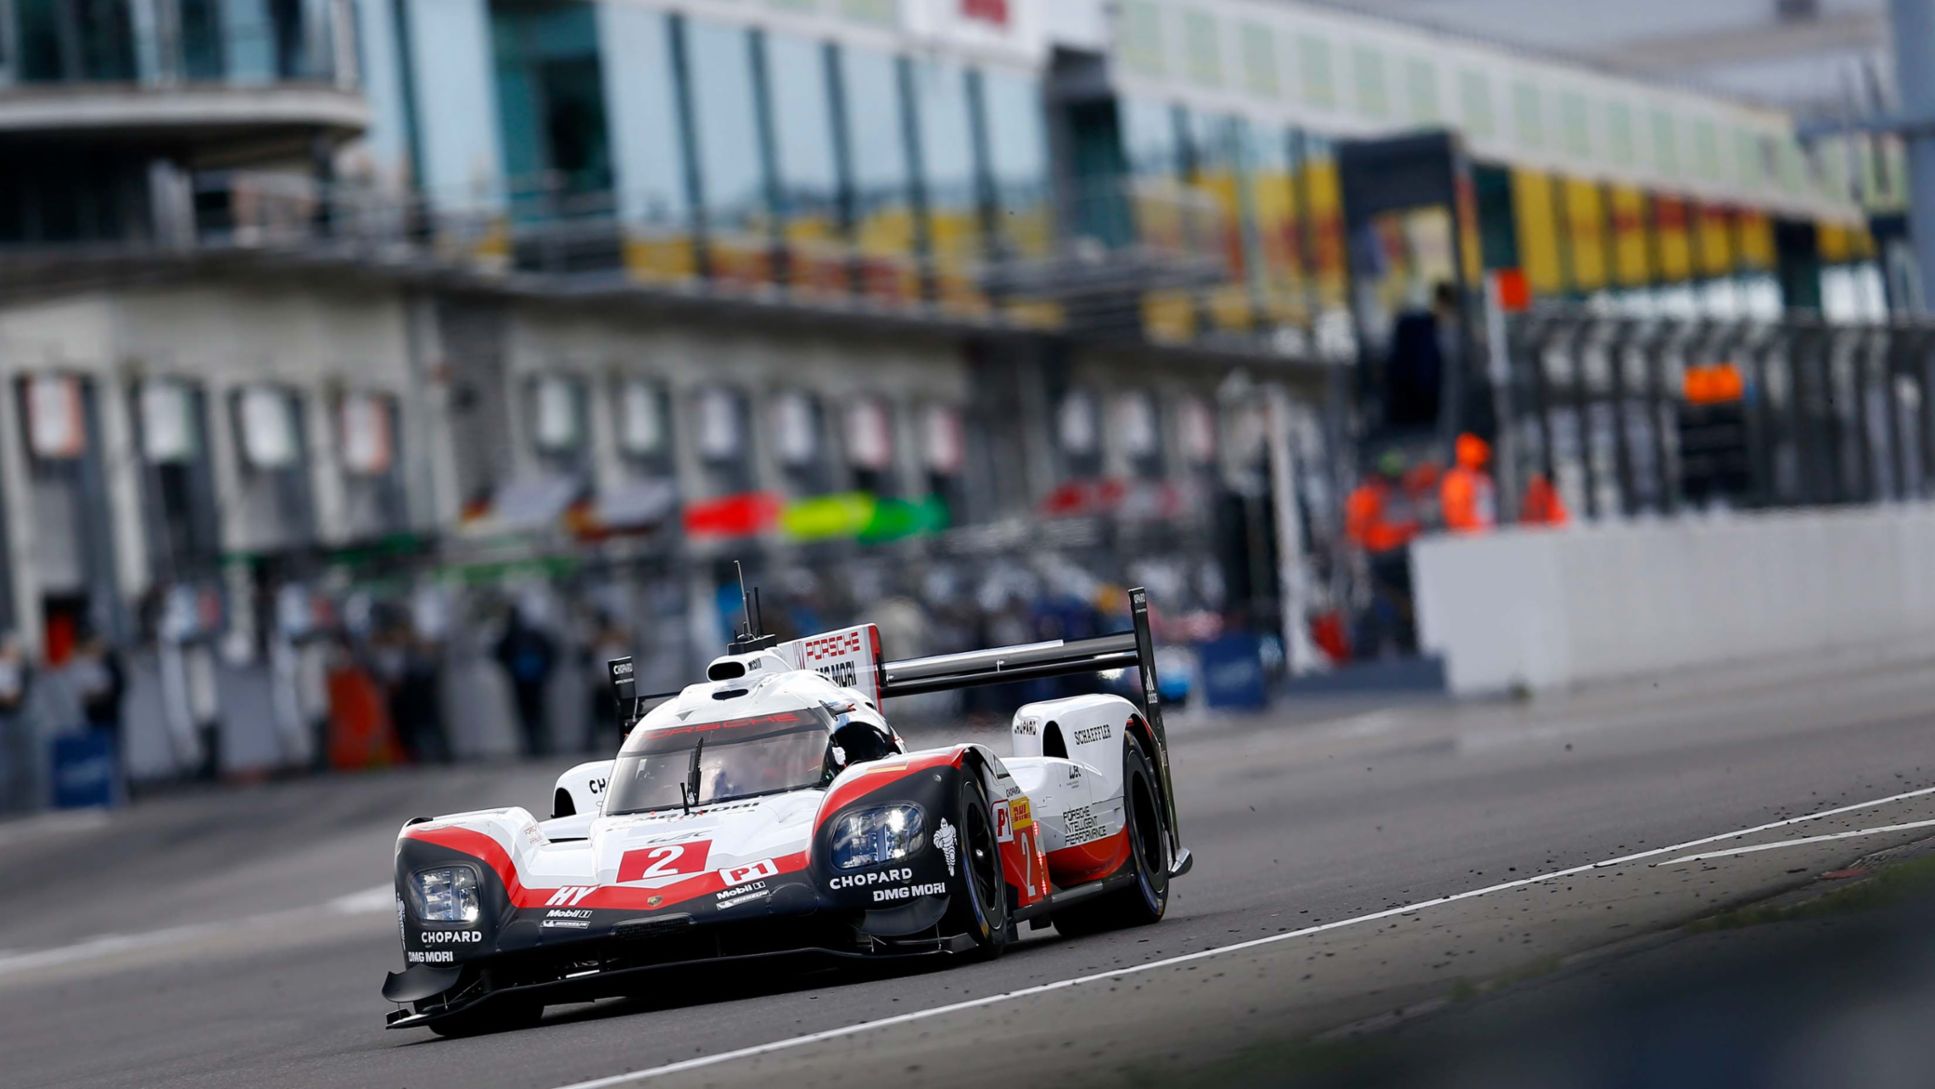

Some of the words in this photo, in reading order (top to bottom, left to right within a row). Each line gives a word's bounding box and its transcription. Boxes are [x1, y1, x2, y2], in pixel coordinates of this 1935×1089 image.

[805, 631, 860, 661] PORSCHE
[1074, 724, 1112, 746] SCHAEFFLER
[1062, 805, 1091, 824] PORSCHE
[1064, 816, 1098, 835] INTELLIGENT
[1065, 825, 1108, 847] PERFORMANCE
[642, 845, 685, 879] 2
[730, 862, 769, 881] P1
[1021, 832, 1037, 897] 2
[829, 867, 913, 890] CHOPARD
[544, 886, 598, 906] HY
[716, 884, 753, 900] Mobil
[873, 887, 910, 902] DMG
[911, 882, 946, 898] MORI
[546, 909, 581, 918] Mobil
[421, 931, 482, 943] CHOPARD
[408, 951, 425, 962] DMG
[425, 951, 453, 962] MORI
